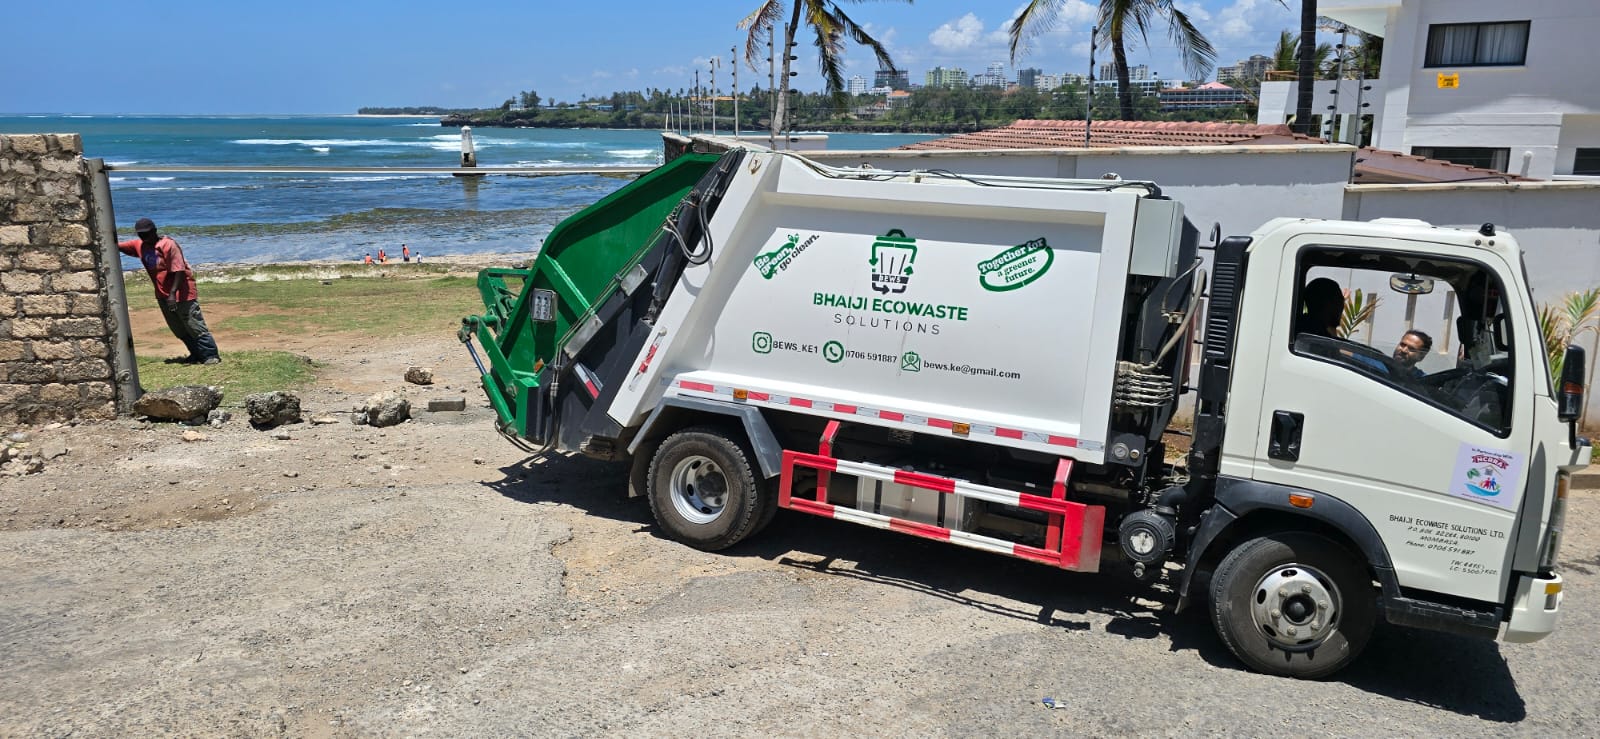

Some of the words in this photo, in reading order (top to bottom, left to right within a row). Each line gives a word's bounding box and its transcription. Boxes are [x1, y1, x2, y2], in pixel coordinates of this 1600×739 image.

[755, 254, 770, 269] Be
[780, 257, 792, 271] go
[791, 233, 820, 259] clean.
[980, 247, 1026, 272] Together
[1026, 240, 1046, 252] for
[1004, 256, 1037, 276] greener
[1005, 267, 1035, 283] future.
[878, 274, 903, 284] BEWS
[813, 292, 868, 310] BHAIJI
[872, 298, 968, 321] ECOWASTE
[834, 313, 940, 335] SOLUTIONS
[772, 340, 819, 354] BEWS_KE1
[845, 350, 865, 360] 0706
[867, 352, 898, 363] 591887
[923, 360, 1021, 380] bews.ke@gmail.com
[1389, 514, 1413, 524] BHAIJI
[1416, 518, 1449, 530] ECOWASTE
[1451, 524, 1487, 536] SOLUTIONS
[1490, 530, 1505, 539] LTD.
[1420, 535, 1458, 545] MOMBASA
